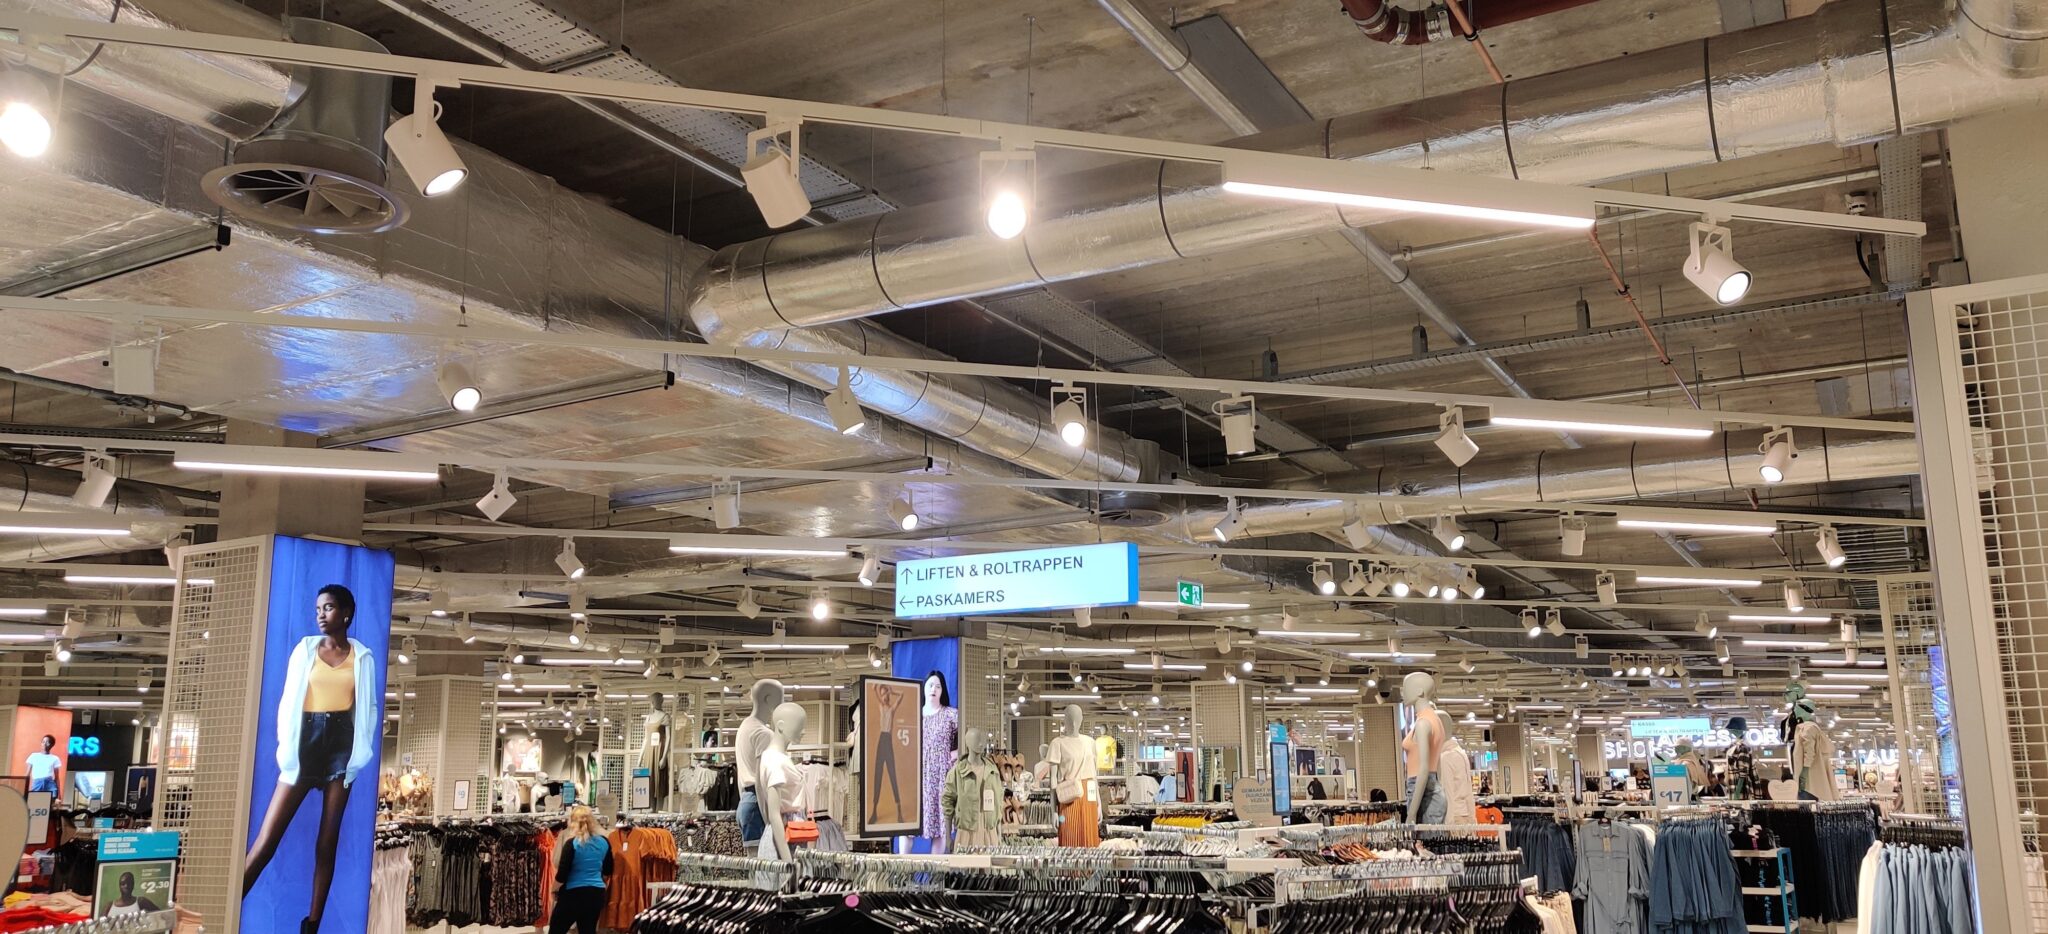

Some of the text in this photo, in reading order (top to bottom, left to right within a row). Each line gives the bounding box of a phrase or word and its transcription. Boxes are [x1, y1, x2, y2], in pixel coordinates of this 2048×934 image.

[916, 555, 1084, 581] LIFTEN & ROLTRAPPEN
[916, 589, 1006, 608] PASKAMERS
[896, 728, 910, 746] €5
[1659, 790, 1683, 802] €17
[29, 808, 48, 817] .50
[140, 880, 170, 894] €2.30
